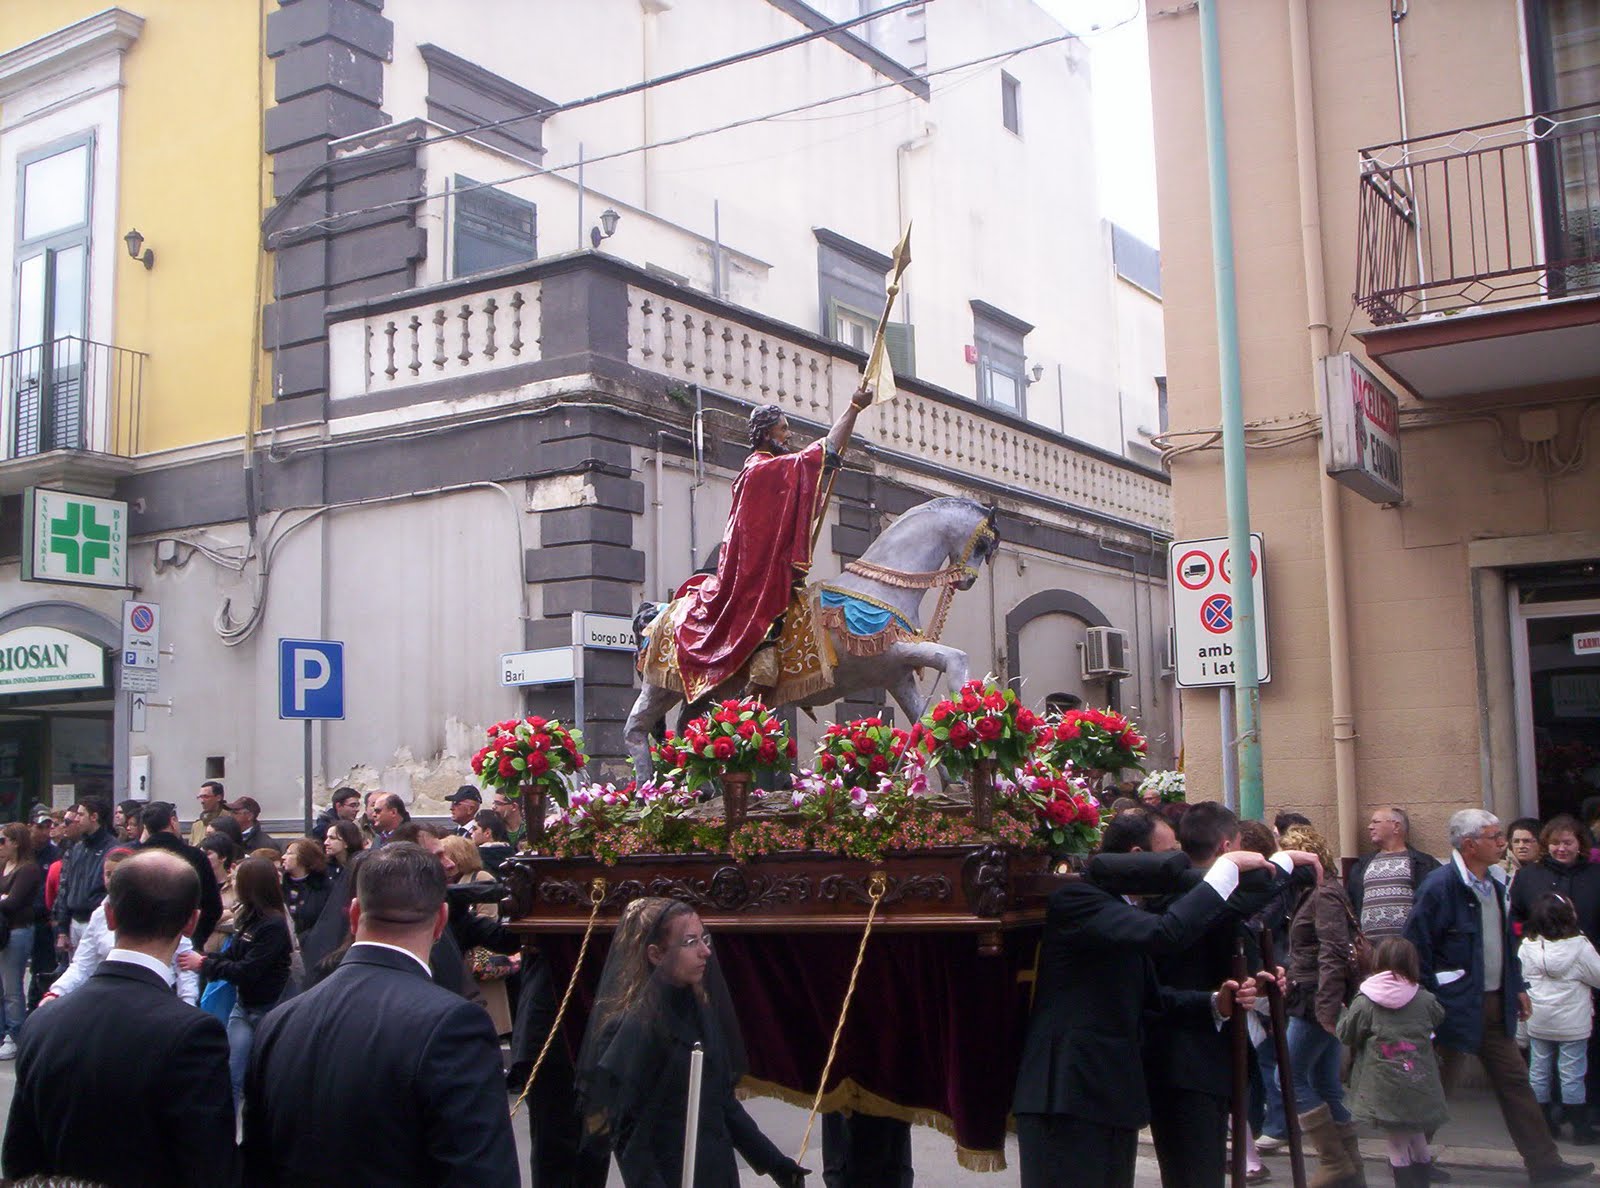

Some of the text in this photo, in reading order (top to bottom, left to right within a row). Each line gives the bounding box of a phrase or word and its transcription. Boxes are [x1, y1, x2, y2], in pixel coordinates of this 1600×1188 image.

[112, 508, 121, 577] BIOSAN
[592, 631, 617, 645] borgo
[505, 670, 525, 682] Bari
[1202, 662, 1206, 676] i
[294, 648, 331, 711] P
